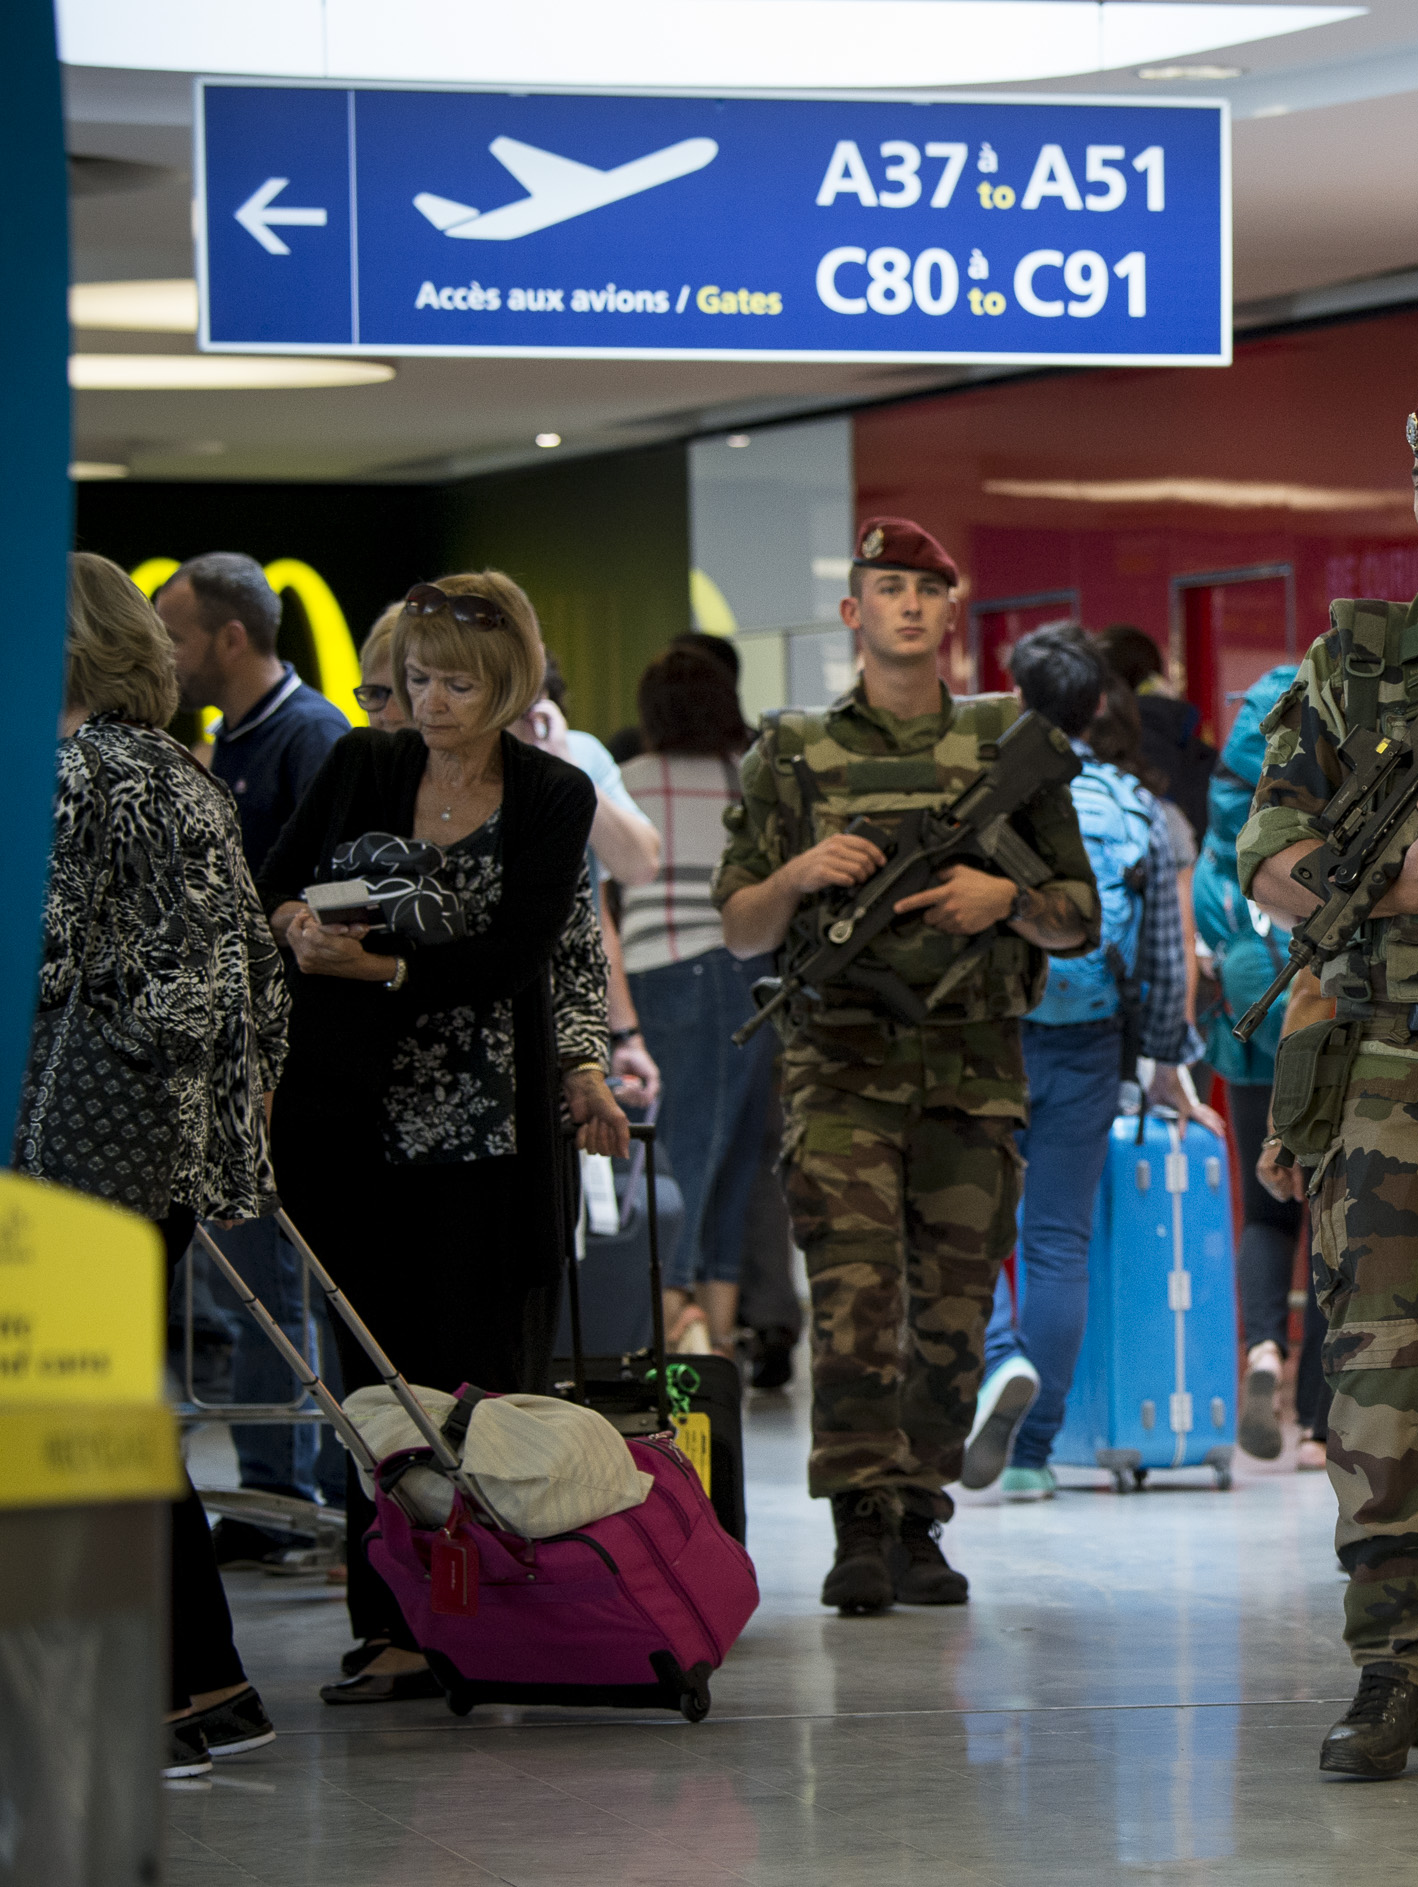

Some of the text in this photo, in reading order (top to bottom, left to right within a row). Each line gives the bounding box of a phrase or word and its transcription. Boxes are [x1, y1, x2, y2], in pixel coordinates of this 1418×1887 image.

[815, 139, 1166, 213] A37 à to A51
[414, 280, 784, 316] Accès aux avions / Gates
[815, 245, 1147, 319] C80 à to C91
